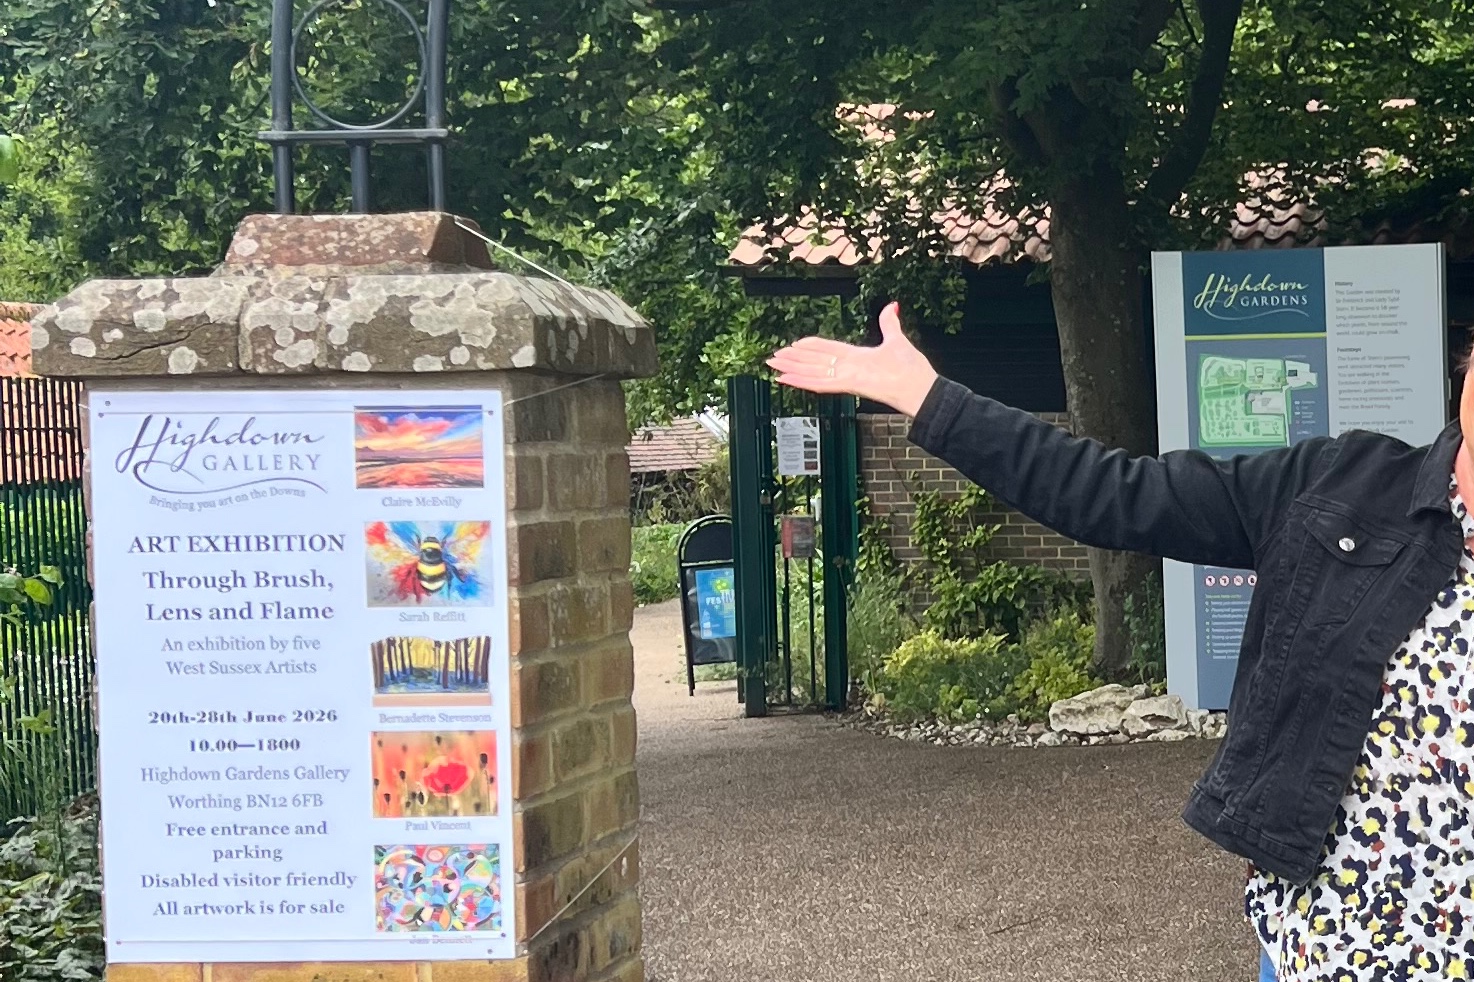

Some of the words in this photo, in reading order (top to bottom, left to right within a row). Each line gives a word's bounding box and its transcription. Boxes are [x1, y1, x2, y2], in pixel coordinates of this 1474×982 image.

[1194, 273, 1309, 309] Highdown
[1240, 295, 1308, 307] GARDENS
[115, 414, 325, 474] Highdown
[202, 454, 321, 472] GALLERY
[149, 495, 195, 512] Bringing
[197, 499, 215, 512] you
[218, 496, 234, 507] art
[235, 494, 249, 503] on
[250, 489, 267, 500] the
[269, 487, 306, 498] Downs
[381, 497, 412, 507] Claire
[416, 497, 462, 509] McEvilly
[128, 536, 180, 553] ART
[188, 534, 345, 552] EXHIBITION
[143, 570, 247, 593] Through
[254, 569, 333, 591] Brush,
[146, 604, 202, 620] Lens
[209, 601, 253, 620] and
[260, 601, 334, 619] Flame
[399, 611, 430, 622] Sarah
[161, 638, 183, 651] An
[188, 636, 265, 651] exhibition
[269, 635, 289, 653] by
[292, 635, 320, 650] five
[166, 661, 205, 675] West
[209, 661, 262, 674] Sussex
[265, 659, 317, 674] Artists
[149, 711, 236, 723] 20th-28th
[243, 711, 286, 723] June
[293, 710, 337, 722] 2026
[379, 713, 436, 724] Bernadette
[438, 713, 491, 723] Stevenson
[141, 766, 220, 784] Highdown
[225, 765, 290, 780] Gardens
[294, 765, 350, 782] Gallery
[168, 794, 242, 811] Worthing
[246, 794, 287, 808] BN12
[292, 793, 324, 807] 6FB
[166, 823, 206, 836] Free
[211, 824, 290, 836] entrance
[295, 821, 327, 834] and
[405, 821, 428, 831] Paul
[431, 821, 471, 831] Vincent
[213, 845, 283, 863] parking
[141, 873, 218, 888] Disabled
[223, 873, 281, 886] visitor
[286, 871, 357, 889] friendly
[153, 901, 178, 915] All
[183, 900, 255, 915] artwork
[260, 901, 274, 914] is
[279, 900, 305, 914] for
[310, 899, 344, 914] sale
